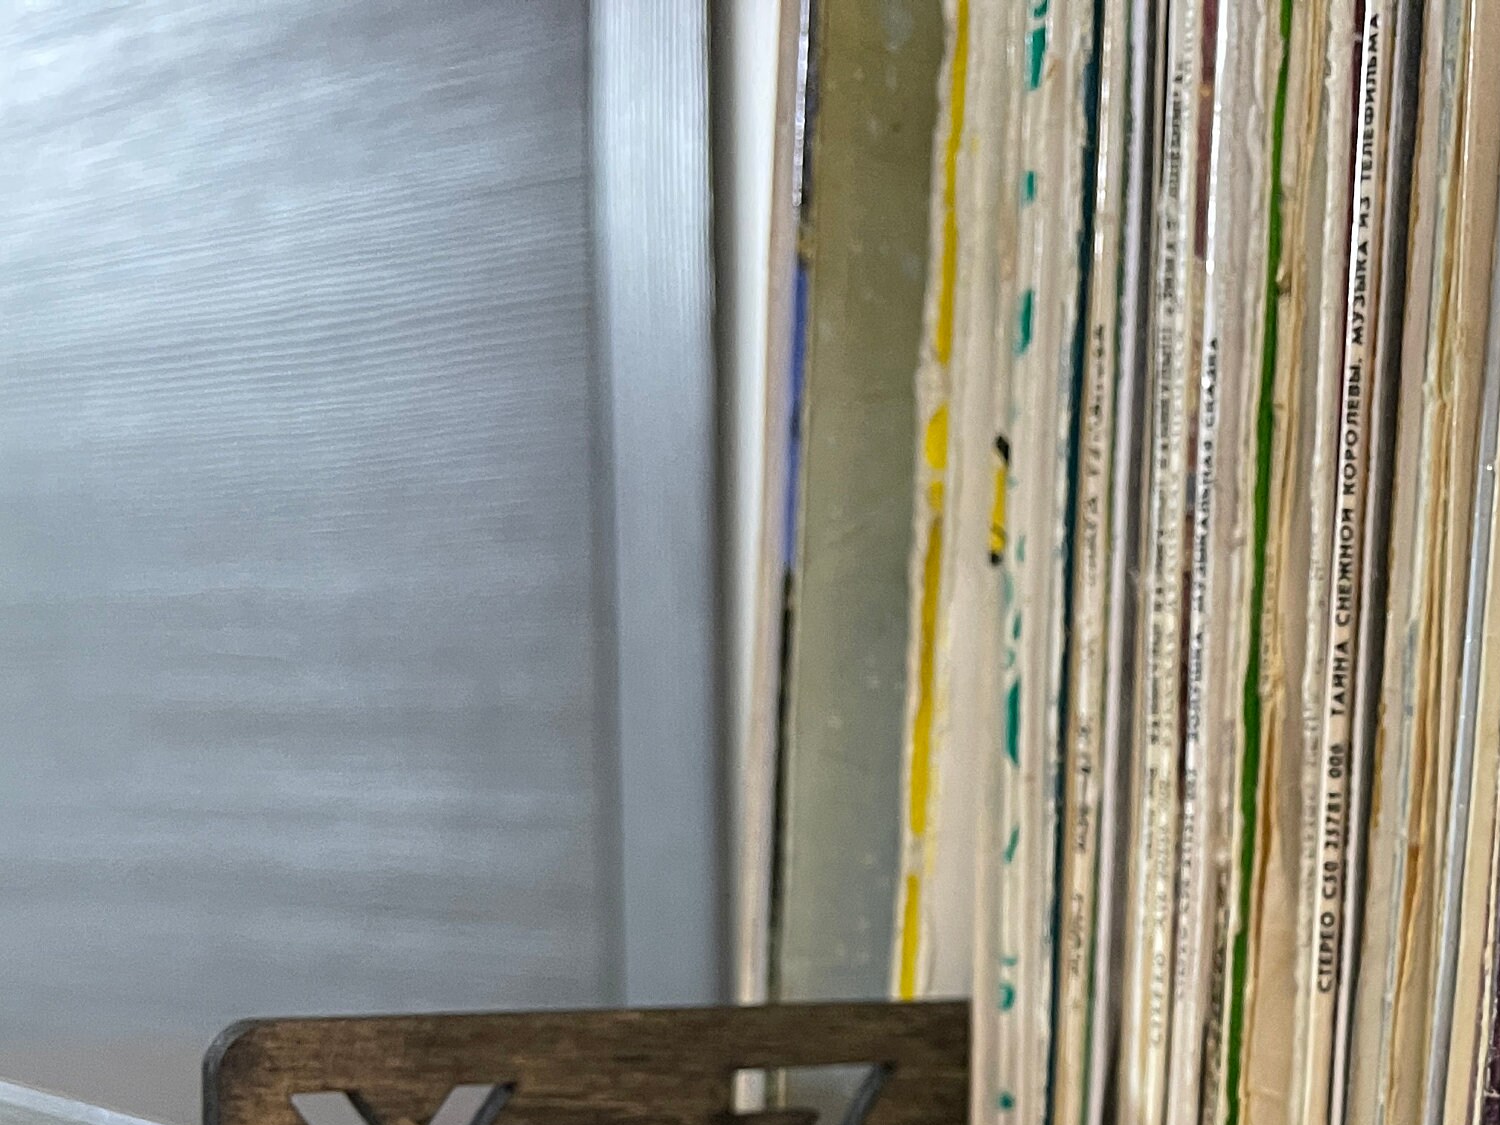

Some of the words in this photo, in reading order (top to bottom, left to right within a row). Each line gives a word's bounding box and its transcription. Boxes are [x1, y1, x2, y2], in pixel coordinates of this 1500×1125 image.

[1359, 11, 1380, 183] ТЕЛЕФИЛЬМА
[1357, 194, 1372, 228] ИЗ
[1349, 239, 1369, 346] МУЗЫКА
[1314, 910, 1336, 993] СТЕРЕО
